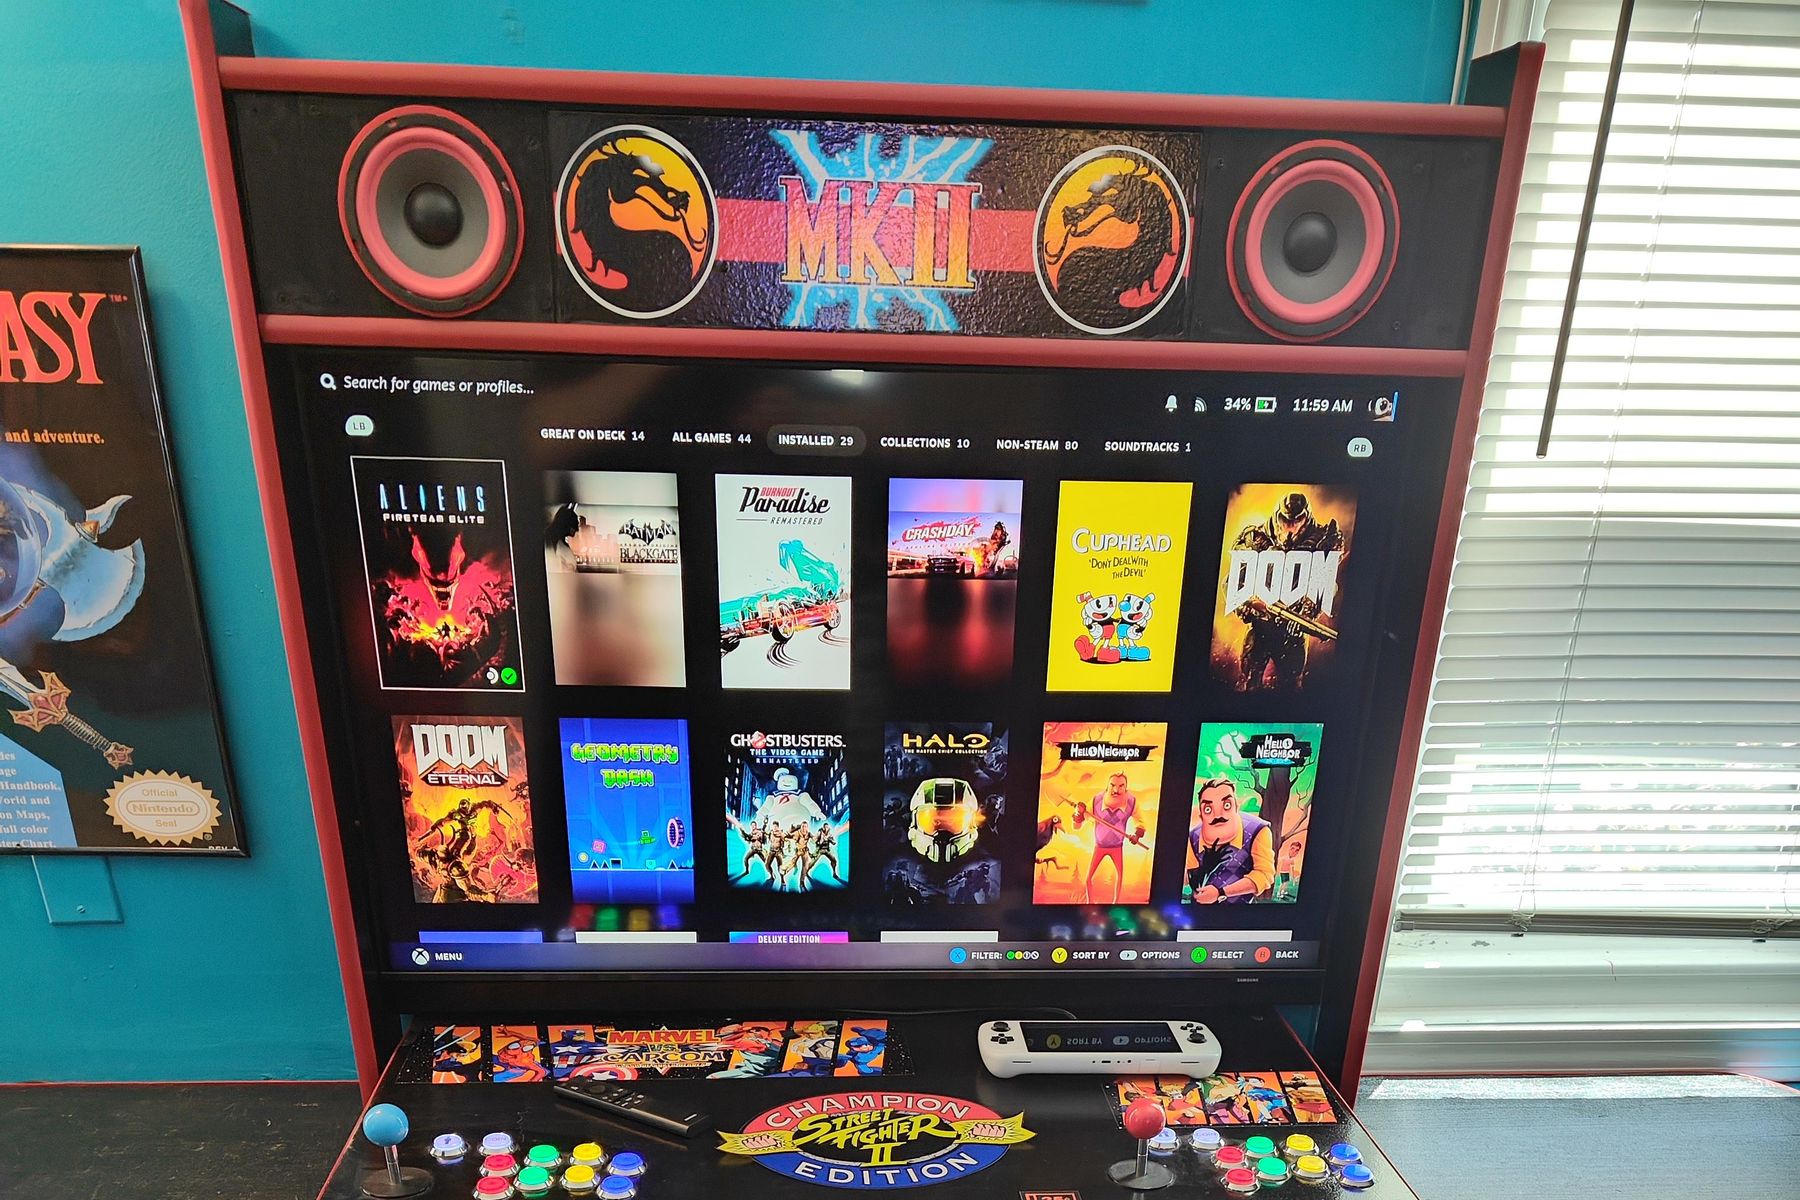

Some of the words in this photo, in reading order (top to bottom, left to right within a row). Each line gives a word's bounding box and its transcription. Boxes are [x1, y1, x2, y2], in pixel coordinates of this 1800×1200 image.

[778, 175, 982, 291] MKII
[343, 376, 387, 390] Search
[390, 377, 410, 392] for
[413, 379, 455, 394] games
[459, 382, 473, 392] or
[476, 380, 534, 396] profiles...
[1224, 398, 1251, 411] 34%
[1293, 399, 1329, 412] 11:59
[1332, 400, 1353, 412] AM
[353, 422, 366, 431] LB
[5, 429, 30, 443] and
[33, 429, 105, 444] adventure.
[540, 428, 575, 439] GREAT
[578, 430, 594, 440] ON
[597, 430, 626, 441] DECK
[632, 430, 645, 441] 14
[672, 432, 692, 443] ALL
[695, 432, 732, 444] GAMES
[737, 433, 751, 444] 44
[778, 434, 834, 446] INSTALLED
[840, 436, 853, 446] 29
[880, 437, 950, 448] COLLECTIONS
[957, 438, 970, 448] 10
[996, 439, 1058, 450] NON-STEAM
[1064, 440, 1078, 450] 80
[1104, 441, 1179, 452] SOUNDTRACKS
[1185, 442, 1191, 452] 1
[1353, 444, 1366, 453] RB
[379, 483, 485, 513] ALIENS
[760, 487, 798, 497] BURNOUT
[739, 486, 831, 514] Paradise
[449, 515, 485, 524] ELITE
[770, 516, 823, 525] REMASTERED
[623, 523, 674, 543] BATMAN
[905, 524, 974, 541] CRASHDAY
[1072, 528, 1172, 554] CUPHEAD
[620, 548, 678, 559] BLACKGATE
[1224, 550, 1342, 618] DOOM
[903, 733, 990, 748] HALO
[410, 724, 509, 778] DOOM
[570, 742, 680, 764] GEOMETRY
[427, 773, 501, 785] ETERNAL
[600, 768, 655, 789] DASH
[142, 788, 178, 797] Official
[30, 796, 51, 805] and
[132, 803, 194, 813] Nintendo
[21, 825, 48, 834] color
[155, 819, 177, 828] Seal
[758, 935, 787, 943] DELUXE
[789, 935, 820, 943] EDITION
[435, 952, 463, 961] MENU
[971, 952, 1003, 960] FILTER:
[1073, 952, 1096, 960] SORT
[1098, 952, 1110, 960] BY
[1141, 951, 1180, 959] OPTIONS
[1212, 951, 1244, 959] SELECT
[1275, 951, 1299, 959] BACK
[608, 1029, 720, 1046] MARVEL
[600, 1051, 726, 1067] CAPCOM
[765, 1094, 970, 1128] CHAMPION
[794, 1108, 895, 1146] STREET
[816, 1114, 957, 1149] FIGHTER
[860, 1142, 908, 1168] II
[794, 1152, 979, 1185] EDITION
